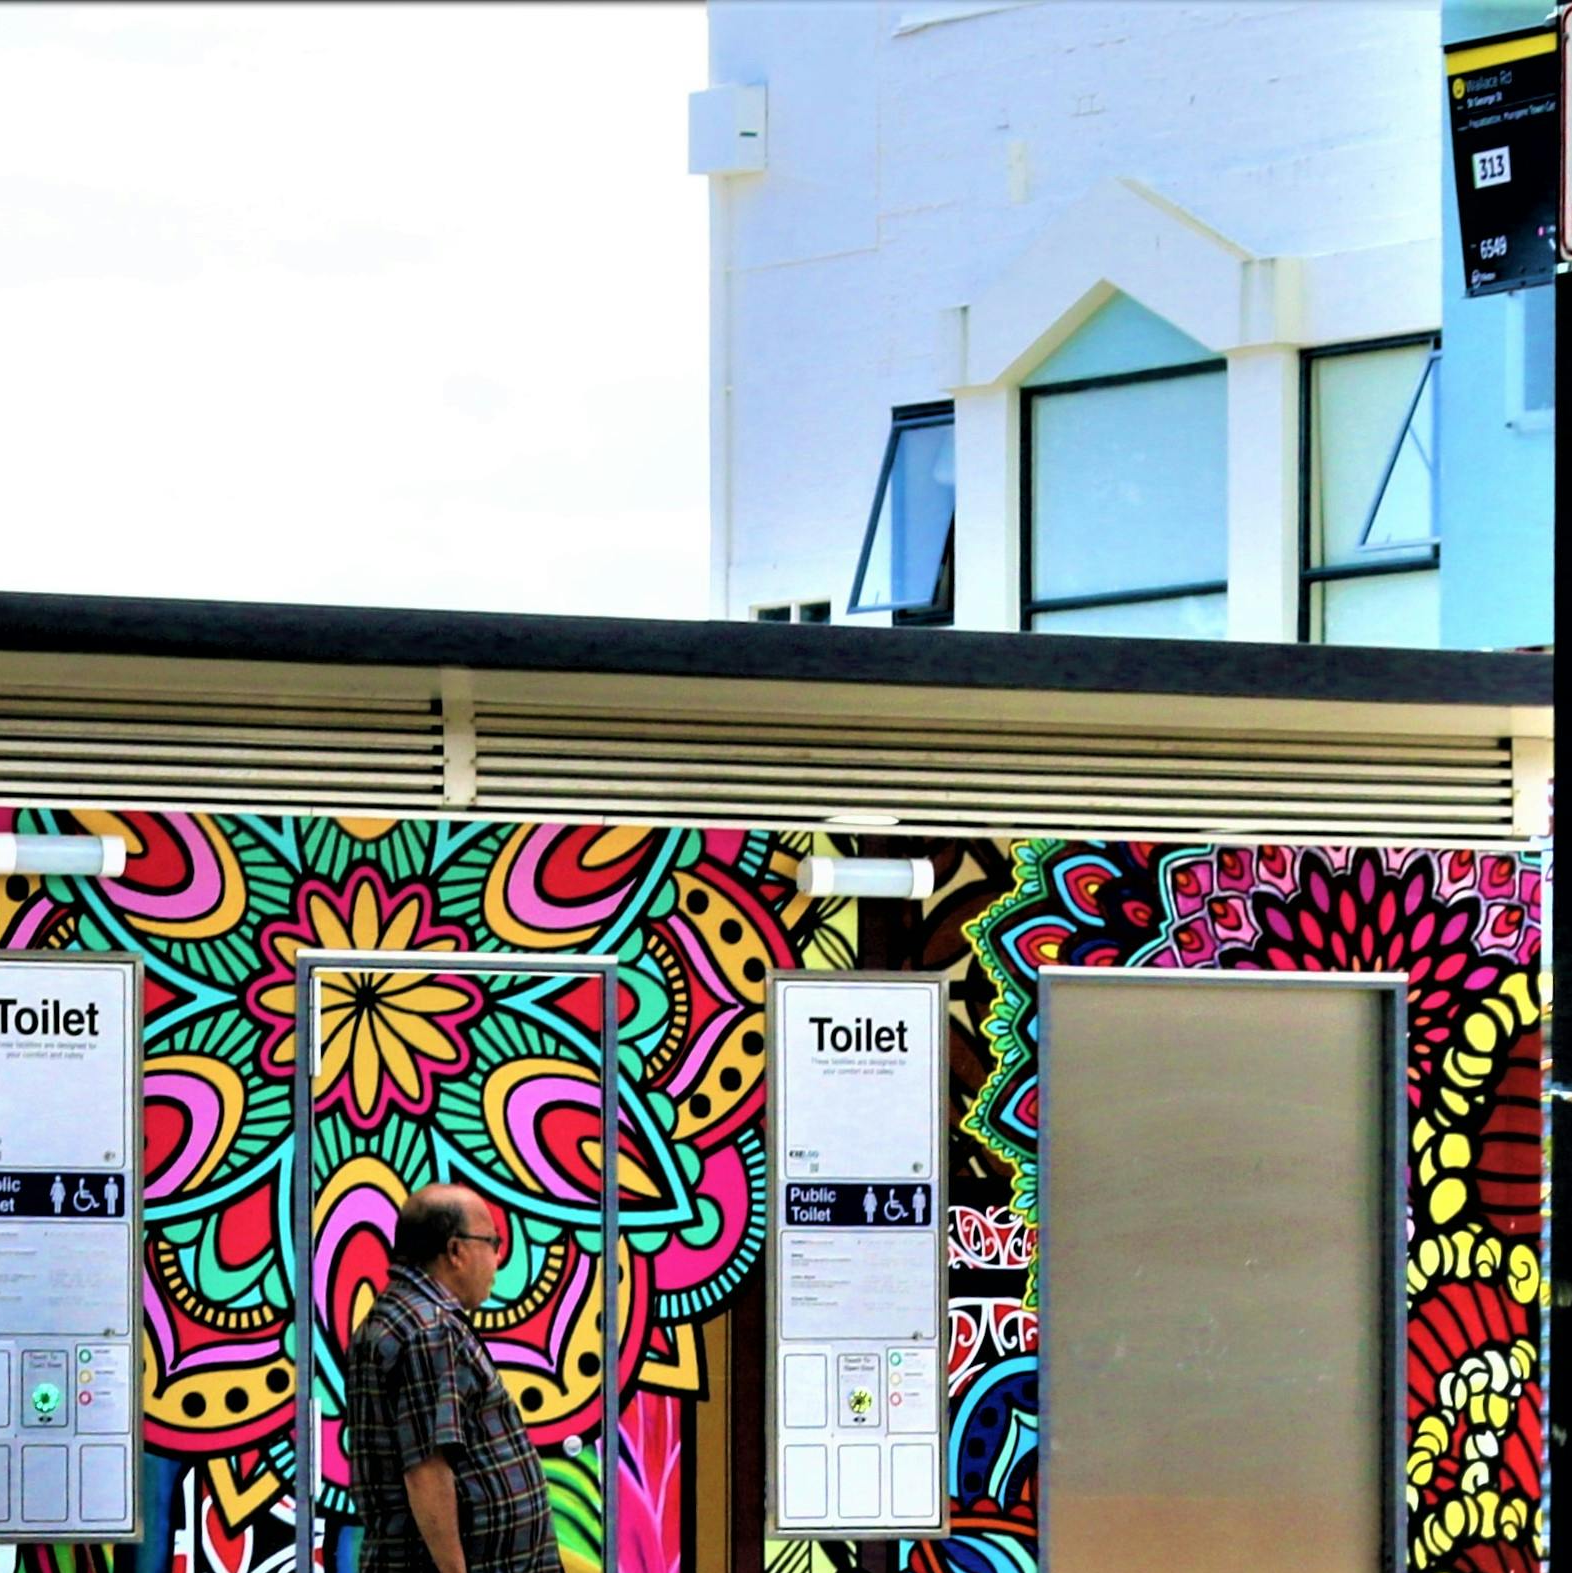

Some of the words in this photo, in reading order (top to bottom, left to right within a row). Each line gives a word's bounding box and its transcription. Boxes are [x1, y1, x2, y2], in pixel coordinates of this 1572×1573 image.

[1479, 154, 1504, 181] 313
[809, 1017, 908, 1053] Toilet
[791, 1187, 836, 1203] Public
[791, 1206, 831, 1222] Toilet
